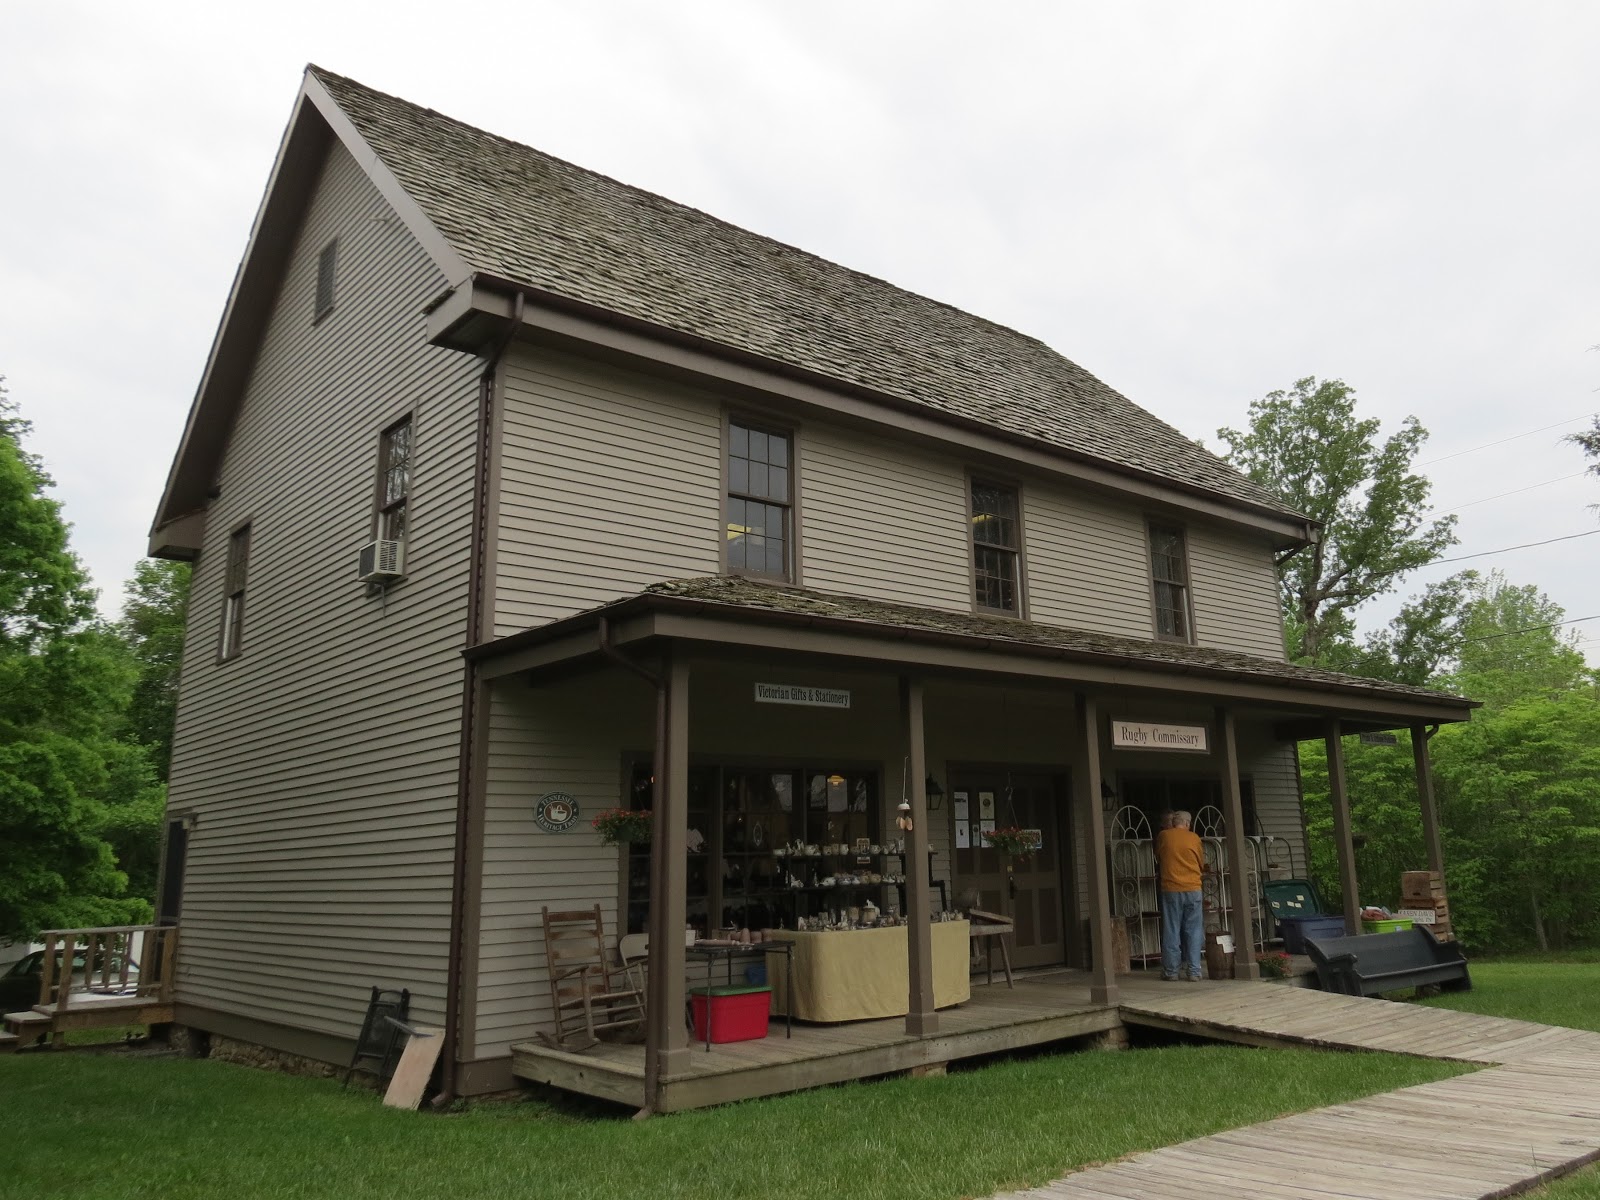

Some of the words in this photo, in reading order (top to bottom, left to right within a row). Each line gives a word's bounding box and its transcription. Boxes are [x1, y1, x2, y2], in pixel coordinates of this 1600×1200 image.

[758, 685, 789, 700] Victorian
[791, 688, 807, 701] Gifts
[808, 689, 815, 701] &
[815, 690, 848, 706] Stationery
[1121, 726, 1147, 744] Rugby
[1152, 728, 1199, 747] Commissary
[541, 795, 575, 806] TENNESSEE
